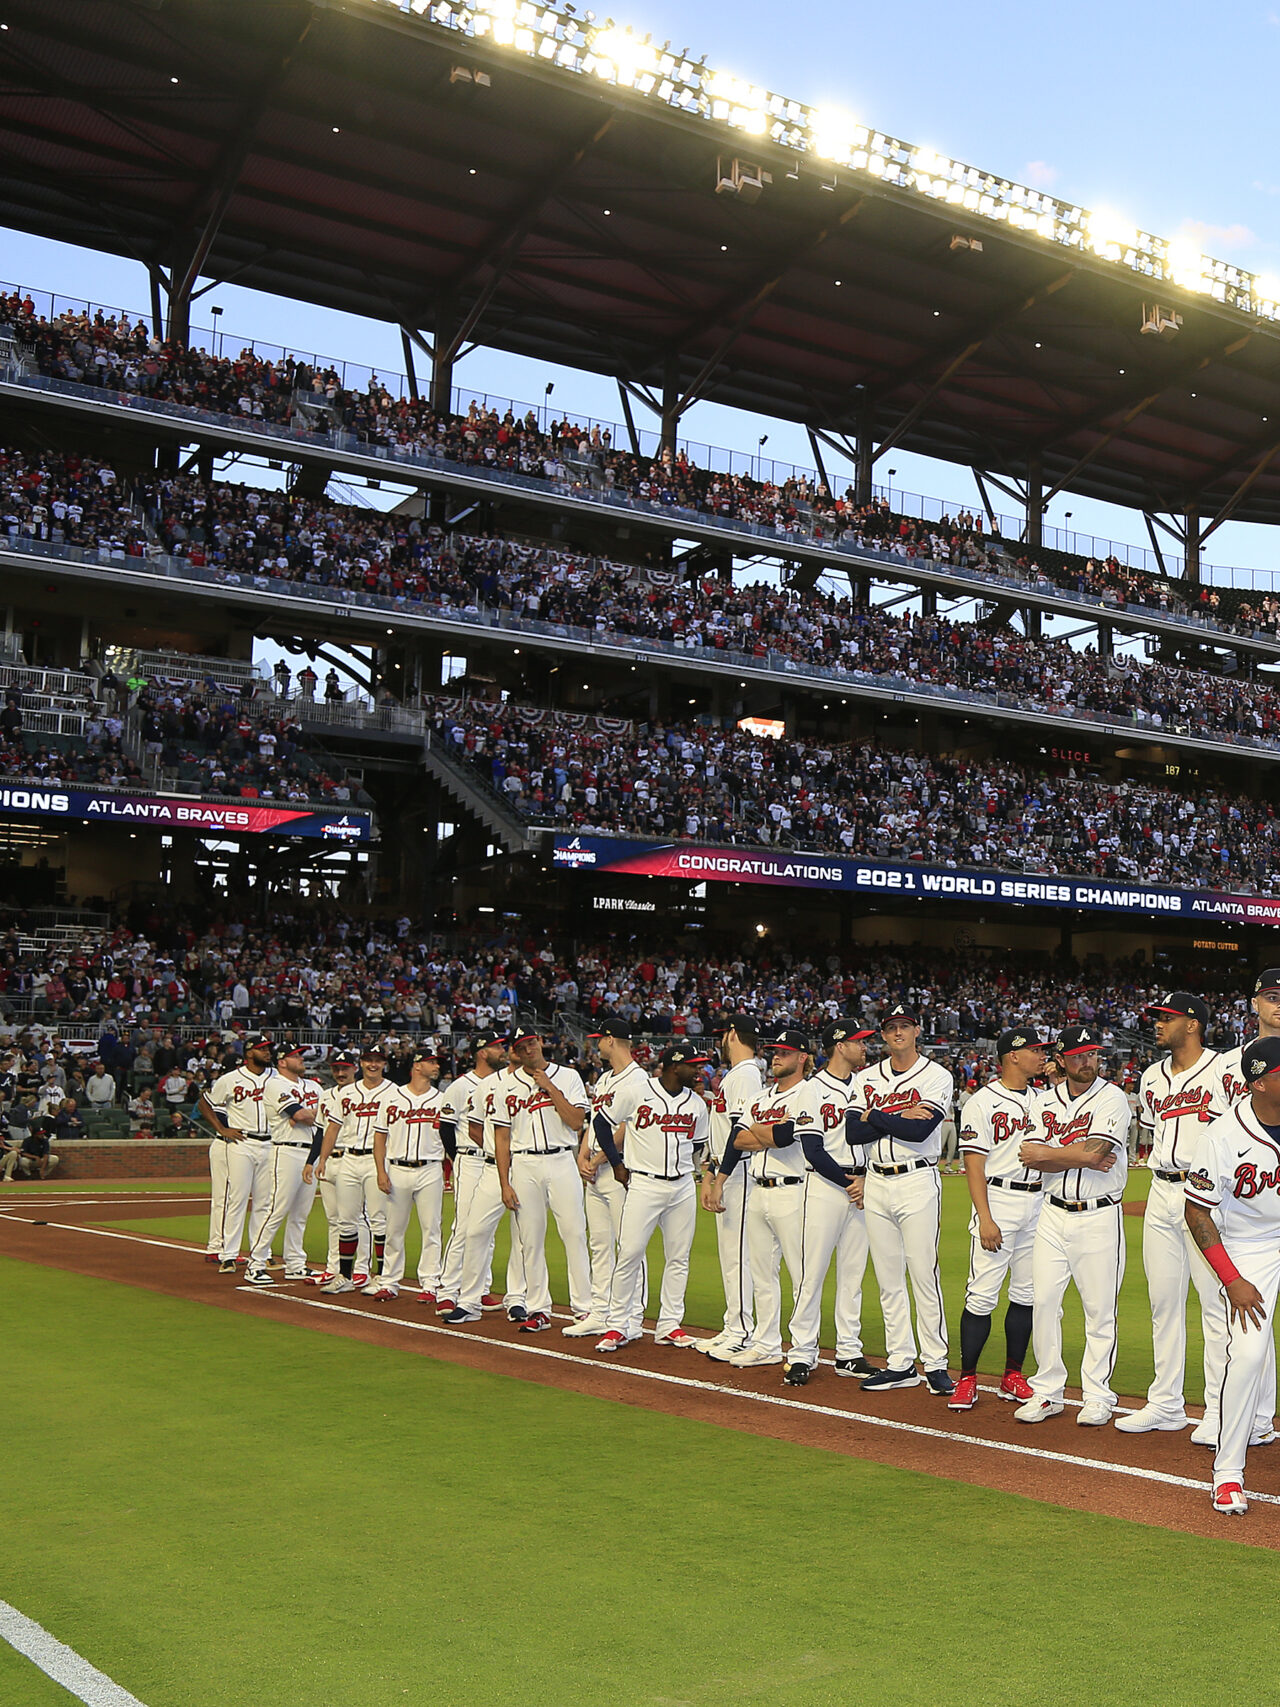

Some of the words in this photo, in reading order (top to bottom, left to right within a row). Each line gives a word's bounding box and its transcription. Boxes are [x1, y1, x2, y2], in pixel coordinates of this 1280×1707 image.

[1052, 748, 1091, 763] SLICE
[0, 789, 69, 811] IONS
[87, 800, 171, 819] ATLANTA
[177, 808, 249, 825] BRAVES
[679, 854, 843, 882] CONGRATULATIONS
[857, 869, 915, 889] 2021
[923, 874, 996, 896] WORLD
[1001, 881, 1071, 902] SERIES
[1076, 887, 1181, 911] CHAMPIONS
[1191, 900, 1245, 915] ATLANTA
[1193, 940, 1216, 950] POTATO
[1217, 942, 1239, 951] CUTTER
[233, 1086, 265, 1104] Bra
[506, 1089, 549, 1117] Brav
[1146, 1085, 1202, 1116] Braves
[1222, 1074, 1252, 1106] Bra
[386, 1106, 437, 1125] Braves
[636, 1104, 695, 1130] Braves
[991, 1111, 1028, 1145] Bra
